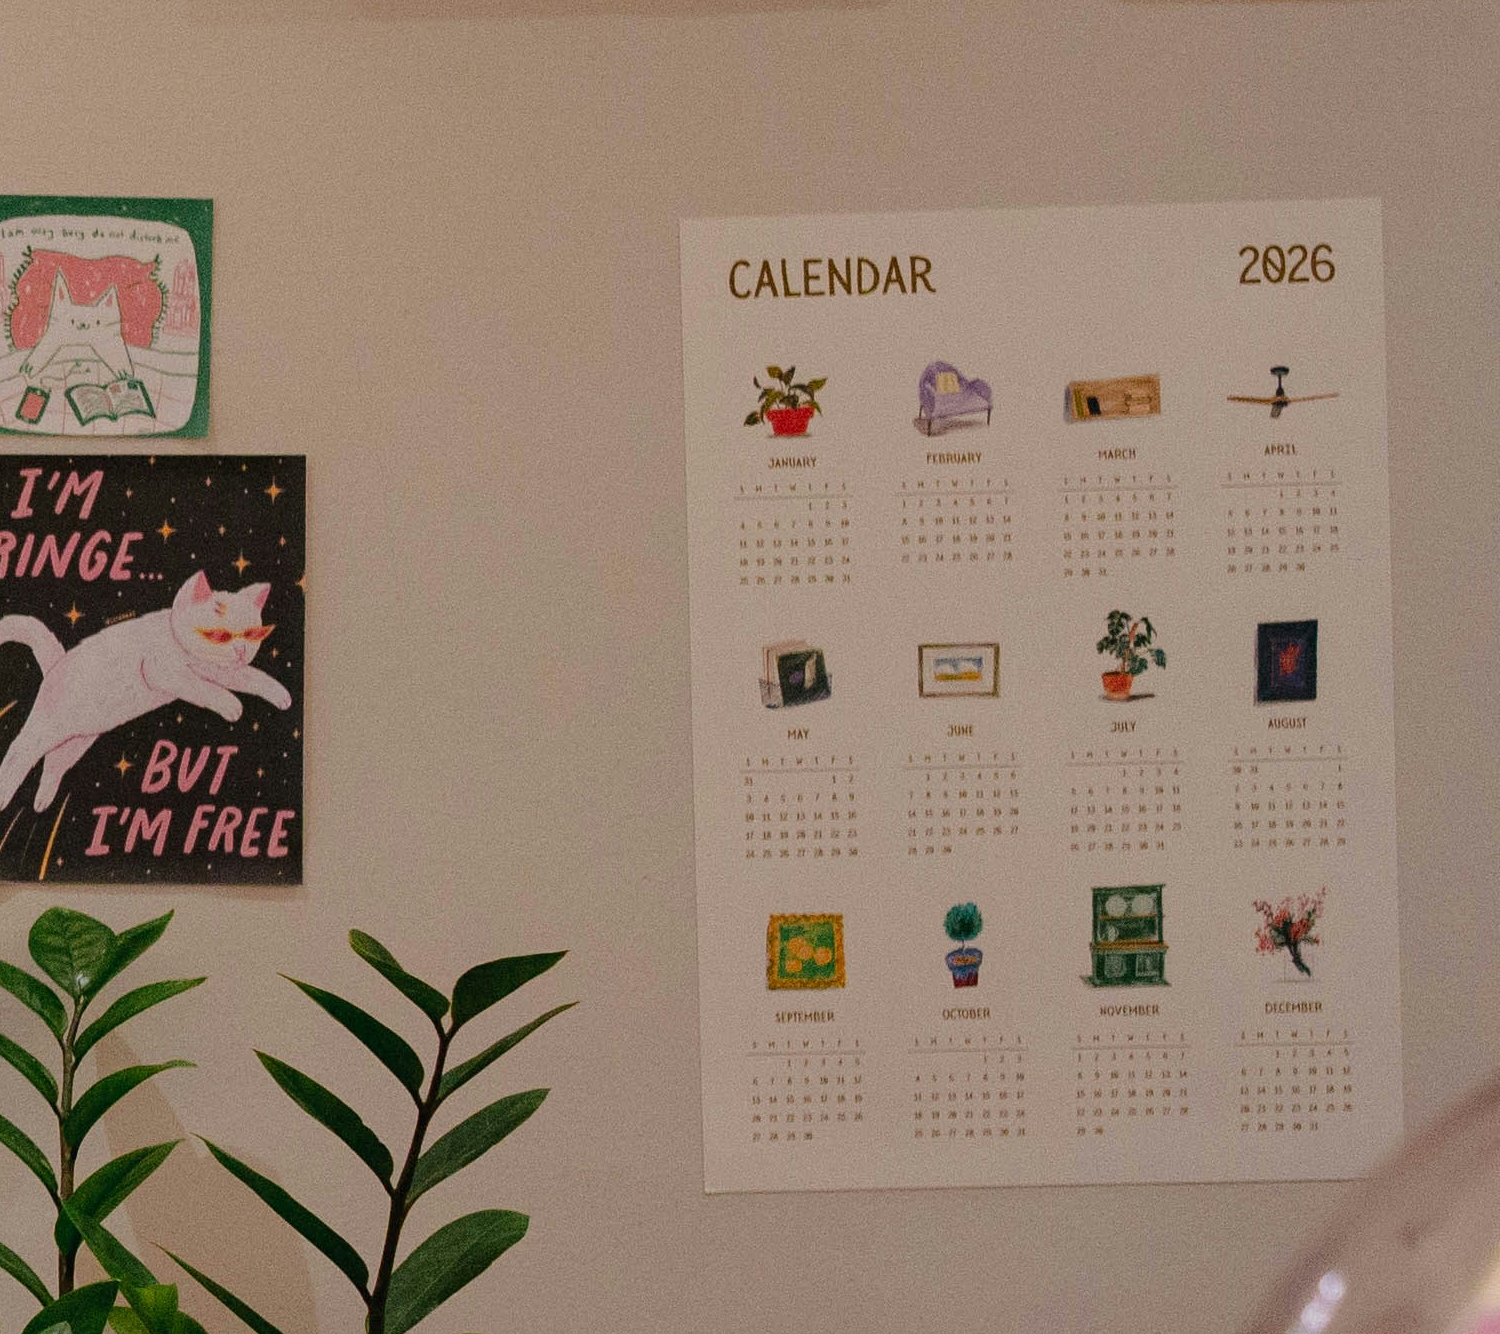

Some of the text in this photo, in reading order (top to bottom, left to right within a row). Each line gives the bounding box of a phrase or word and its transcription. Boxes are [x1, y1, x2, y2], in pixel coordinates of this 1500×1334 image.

[1237, 243, 1338, 288] 2026
[727, 253, 938, 302] CALENDAR
[1096, 447, 1138, 462] MARCH
[1262, 442, 1300, 457] APRIL
[766, 455, 819, 470] JANUARY
[925, 451, 984, 466] FEBRUARY
[8, 466, 107, 523] I'M
[946, 722, 976, 738] JUNE
[1109, 719, 1138, 735] JULY
[1266, 716, 1309, 732] AUGUST
[785, 726, 812, 742] MAY
[140, 737, 240, 796] BUT
[83, 804, 298, 861] I'M FREE
[941, 1006, 993, 1023] OCTOBER
[1098, 1003, 1162, 1018] NOVEMBER
[1263, 1000, 1325, 1016] DECEMBER
[774, 1009, 836, 1025] SEPTEMBER
